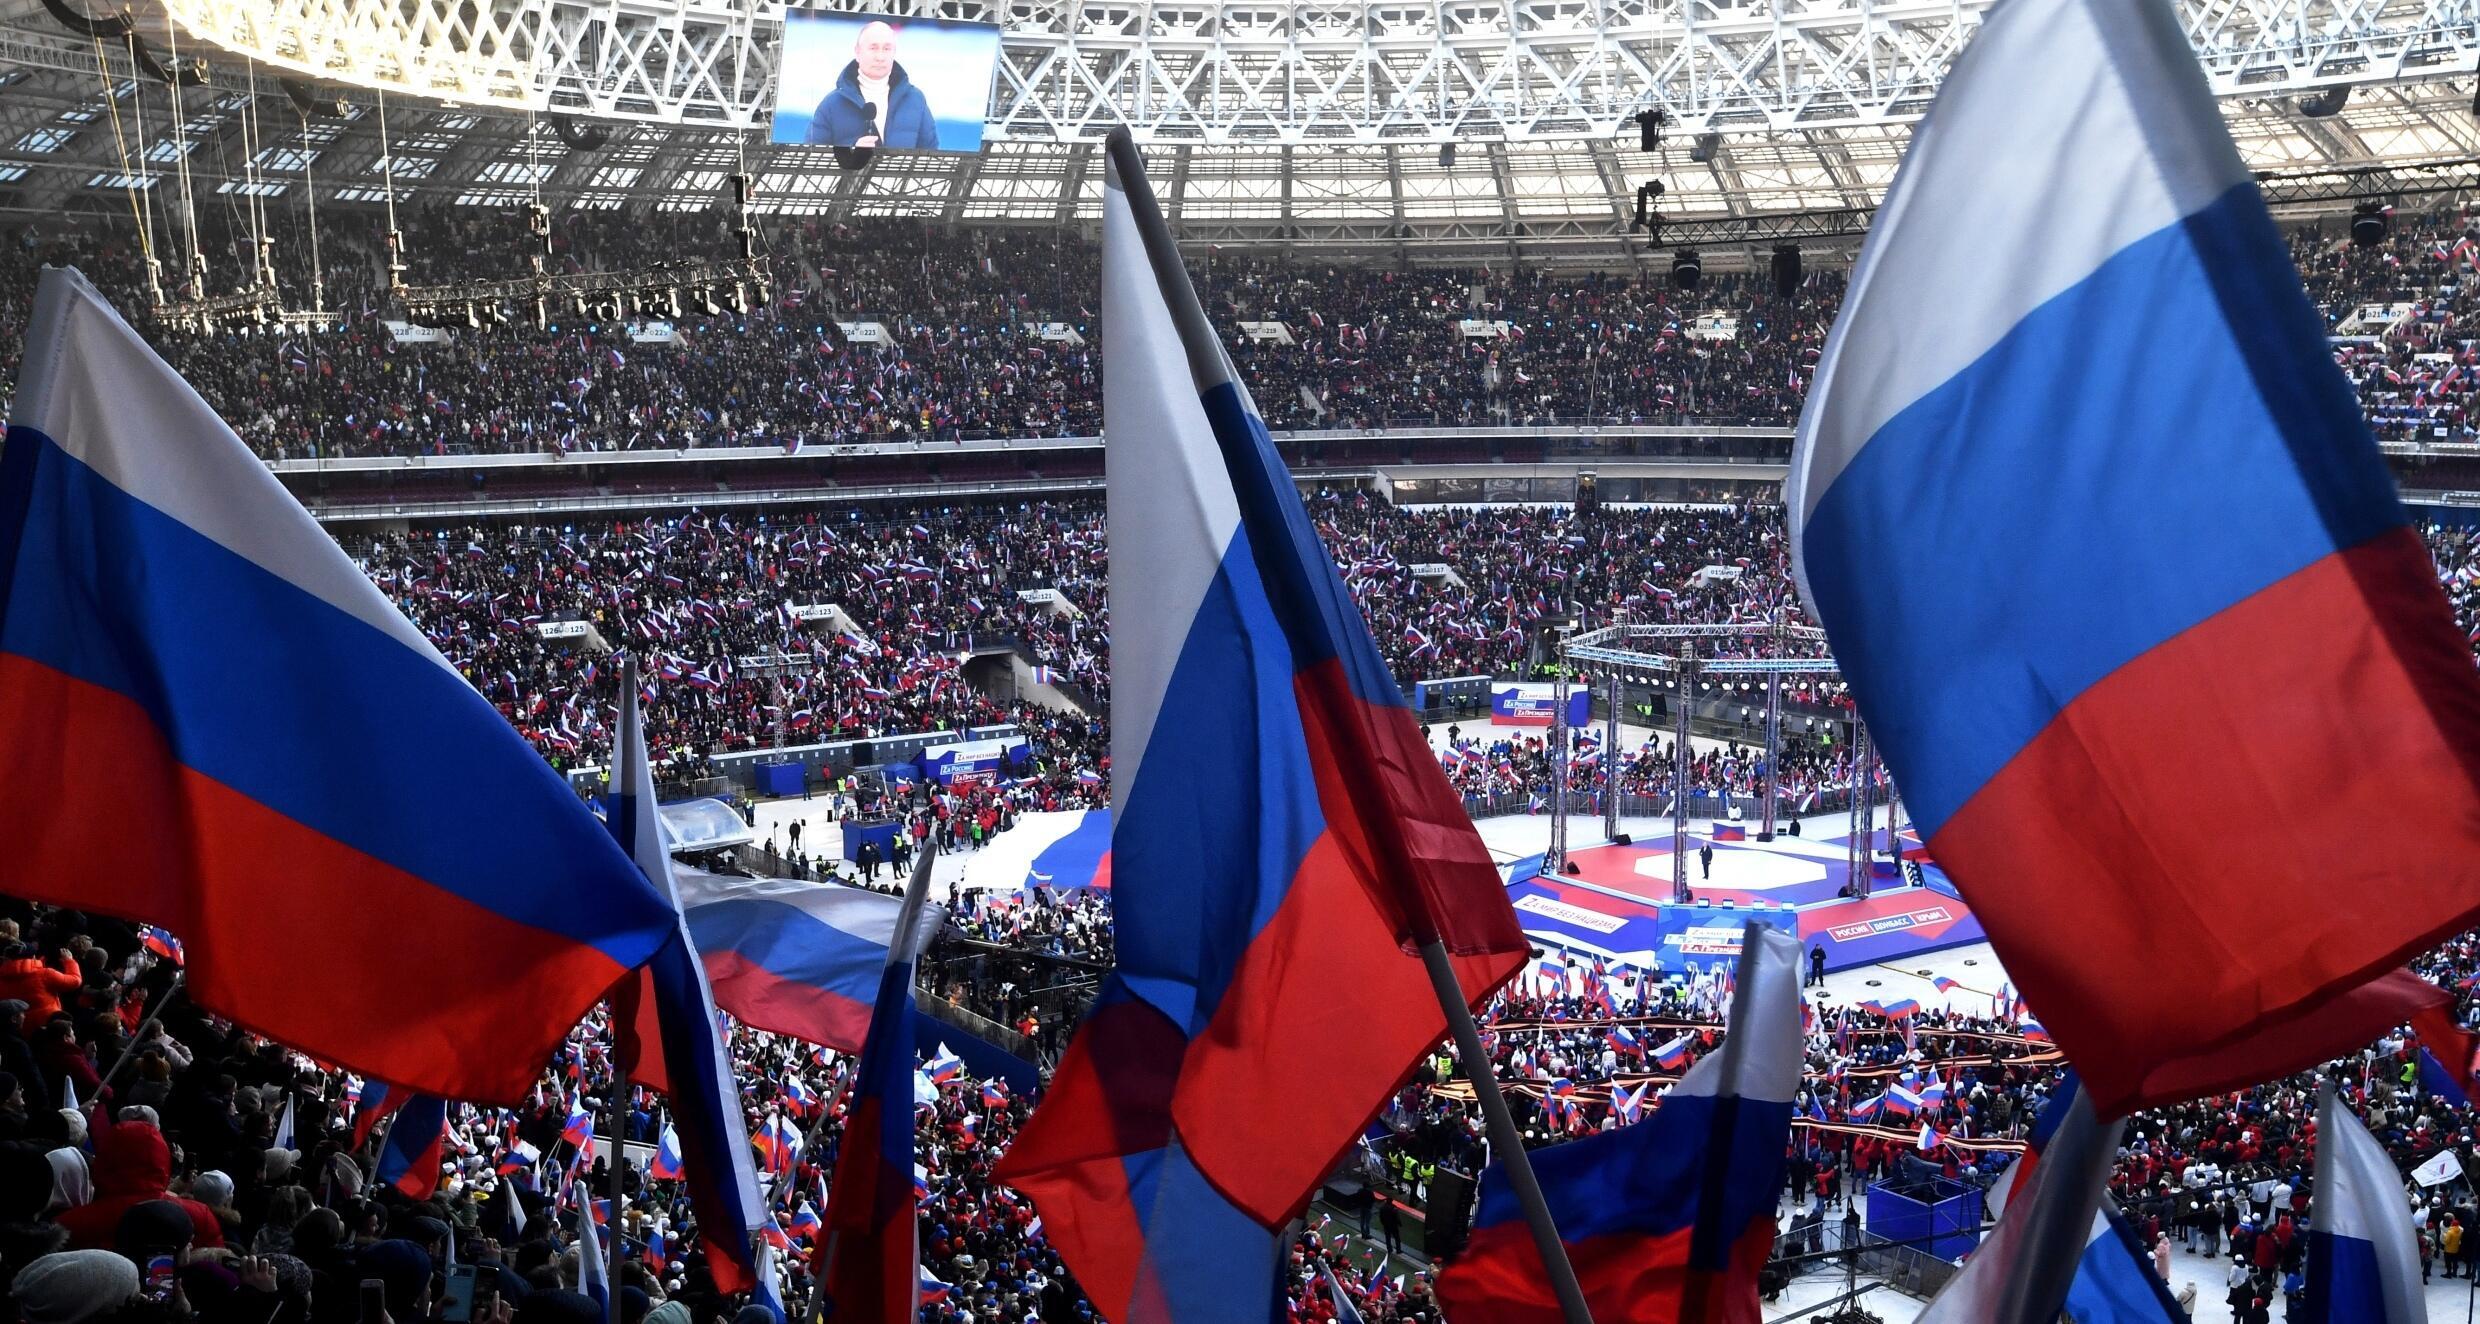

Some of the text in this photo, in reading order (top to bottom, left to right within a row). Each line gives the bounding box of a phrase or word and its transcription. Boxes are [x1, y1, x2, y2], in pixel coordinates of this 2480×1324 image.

[820, 608, 832, 616] 123
[545, 625, 584, 635] 126 125
[1835, 910, 1944, 938] РОССИЯ ДОНБАСС КРЫМ
